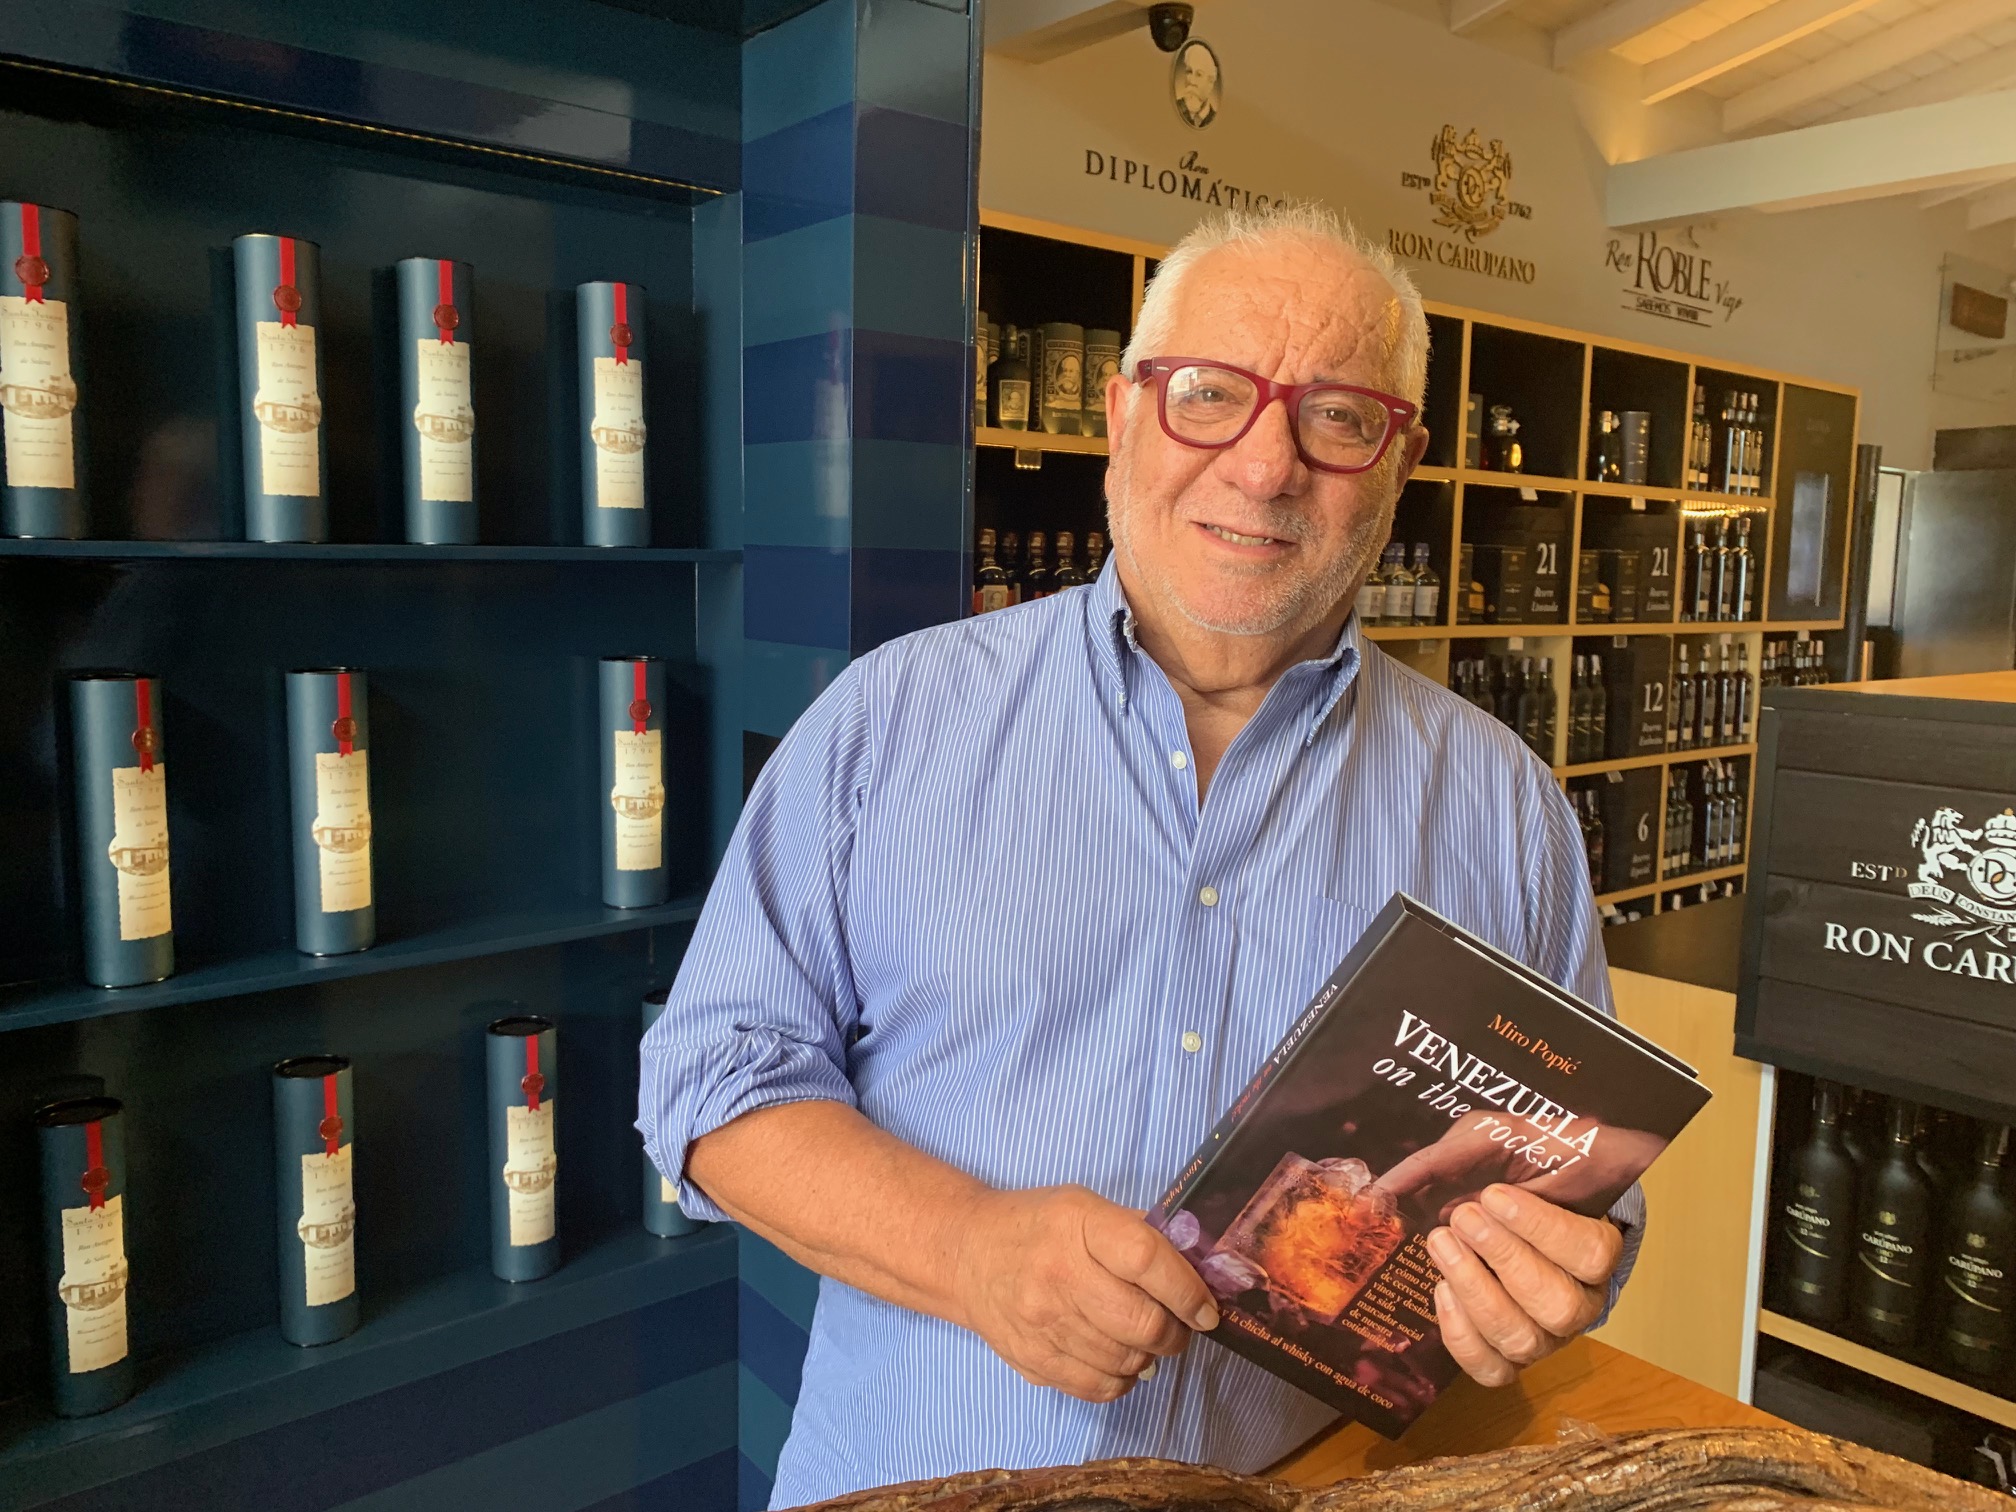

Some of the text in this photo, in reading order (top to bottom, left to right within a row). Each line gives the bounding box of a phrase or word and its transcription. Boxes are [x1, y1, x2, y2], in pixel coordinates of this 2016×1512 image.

[1389, 228, 1433, 262] RON
[1633, 230, 1713, 302] ROBLE
[1535, 542, 1557, 575] 21
[1651, 546, 1669, 577] 21
[1643, 682, 1664, 713] 12
[1637, 812, 1650, 842] 6
[1910, 884, 1951, 901] DEUS
[1824, 922, 2016, 985] RON CAR
[1273, 983, 1338, 1064] VENEZUELA
[1487, 1013, 1583, 1076] Miro Popić
[1393, 1008, 1600, 1157] VENEZUELA
[1372, 1057, 1582, 1176] on the rocks!
[1395, 1252, 1426, 1275] hemos
[1404, 1244, 1417, 1255] de
[1416, 1250, 1427, 1260] lo
[1373, 1281, 1397, 1299] vinos
[1393, 1295, 1404, 1304] y
[1380, 1272, 1430, 1307] de cervezas,
[1385, 1263, 1396, 1272] y
[1395, 1267, 1420, 1285] cómo
[1420, 1281, 1431, 1290] el
[1364, 1288, 1396, 1312] ha sido
[1341, 1318, 1396, 1353] cotidianidad.
[1349, 1308, 1394, 1338] de nuestra
[1356, 1300, 1425, 1342] marcador social
[1228, 1310, 1239, 1324] la
[1239, 1318, 1272, 1341] chicha
[1270, 1335, 1284, 1347] al
[1281, 1341, 1316, 1367] whisky
[1314, 1360, 1334, 1376] con
[1332, 1371, 1358, 1391] agua
[1357, 1383, 1371, 1397] de
[1370, 1394, 1394, 1410] coco
